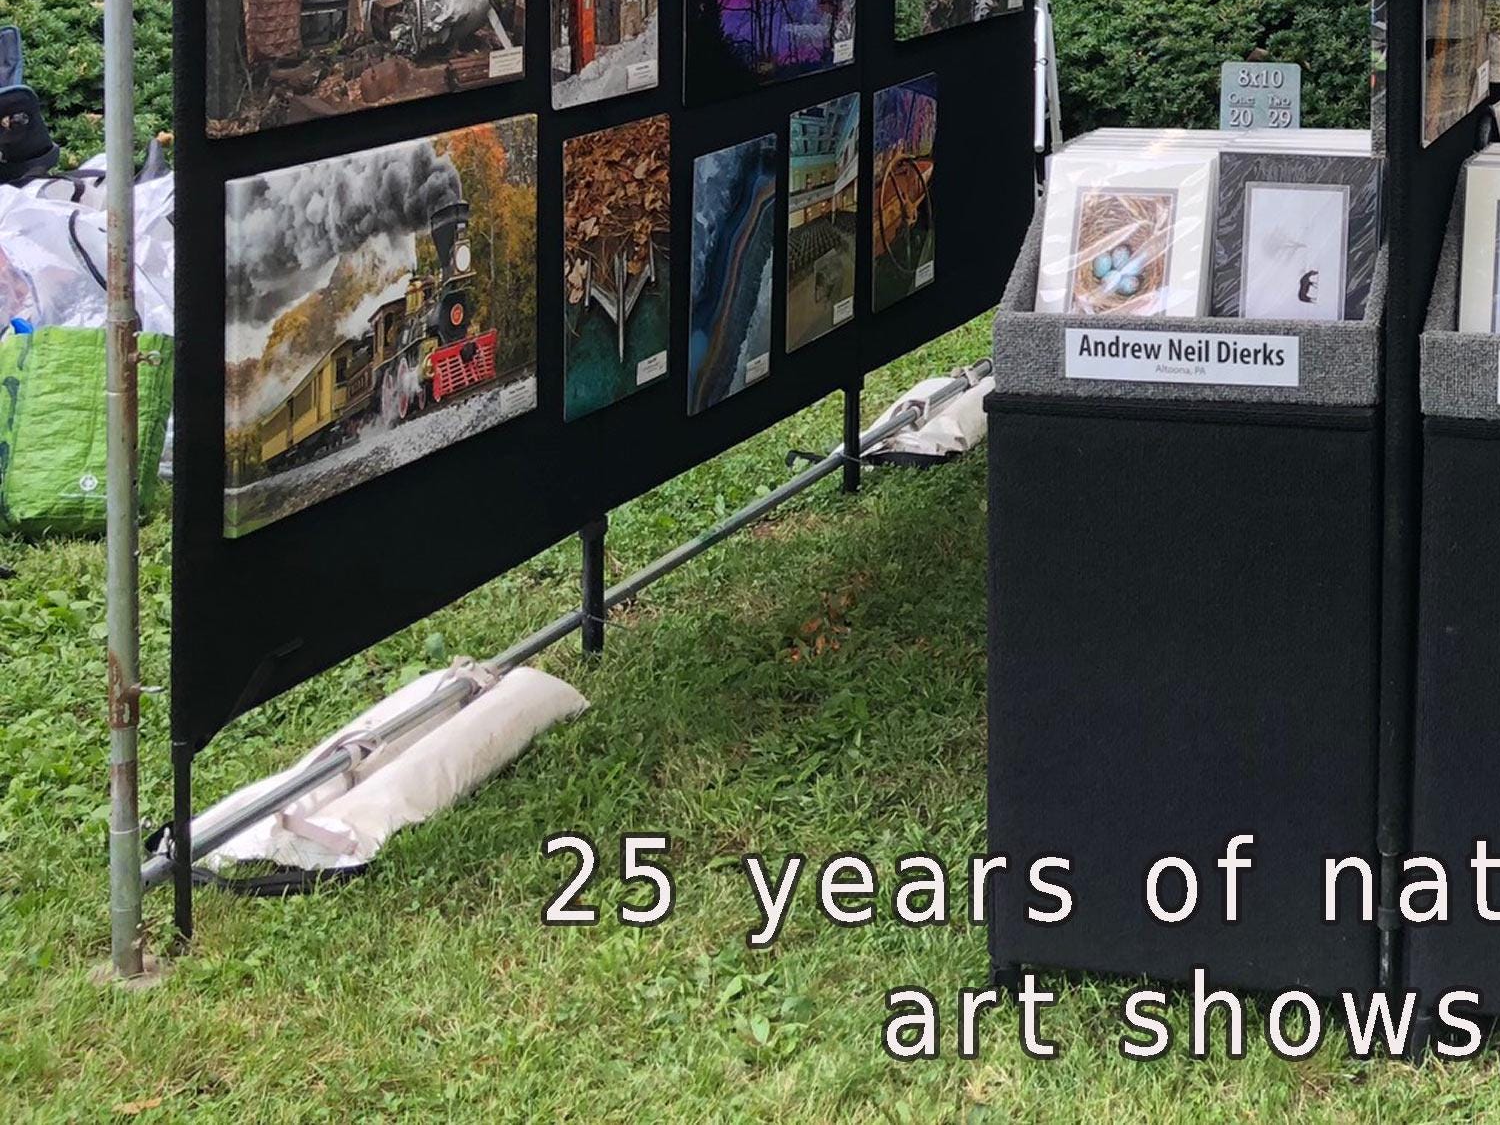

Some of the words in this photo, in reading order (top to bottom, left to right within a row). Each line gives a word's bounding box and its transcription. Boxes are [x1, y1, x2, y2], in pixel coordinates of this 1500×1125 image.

[1238, 68, 1284, 88] 8x10
[1230, 108, 1253, 127] 20
[1268, 109, 1293, 128] 29
[1078, 334, 1162, 360] Andrew
[1168, 338, 1210, 363] Neil
[1216, 341, 1285, 366] Dierks
